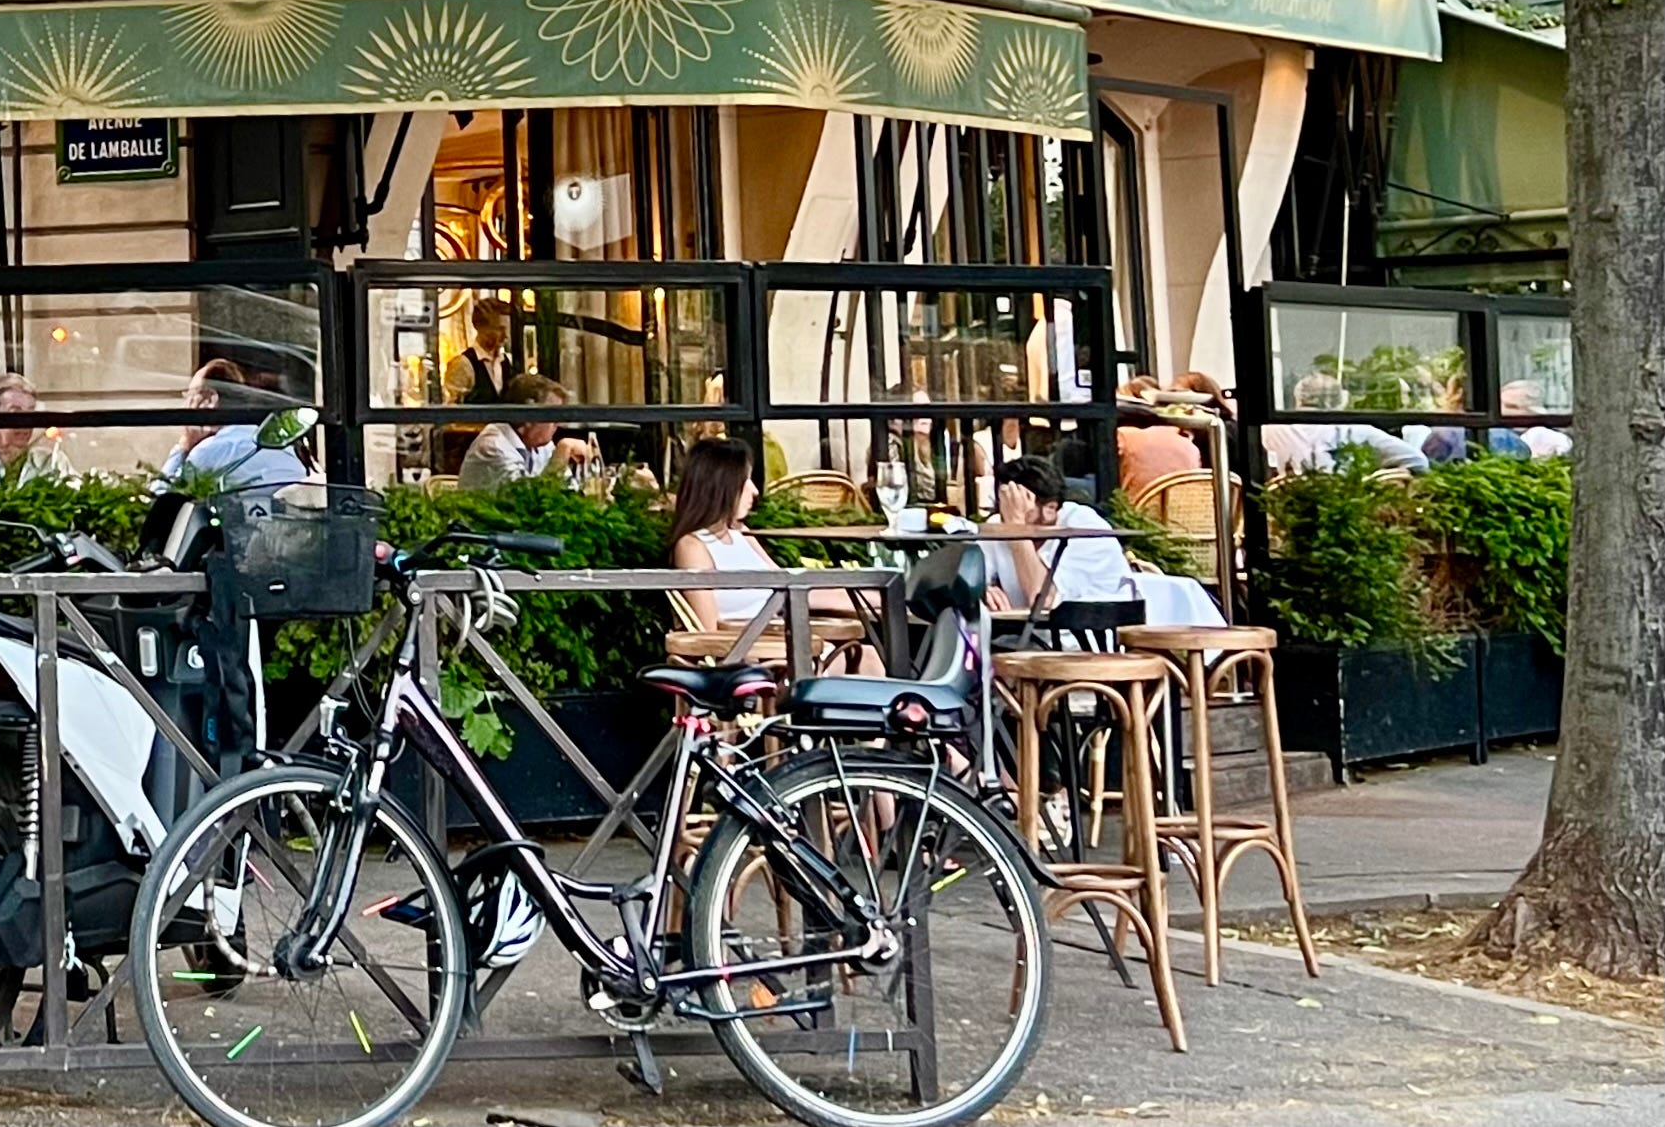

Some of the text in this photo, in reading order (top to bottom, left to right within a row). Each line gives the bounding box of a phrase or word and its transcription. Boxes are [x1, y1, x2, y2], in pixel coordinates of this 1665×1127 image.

[88, 118, 143, 131] AVENUE
[68, 138, 163, 161] DE LAMBALLE
